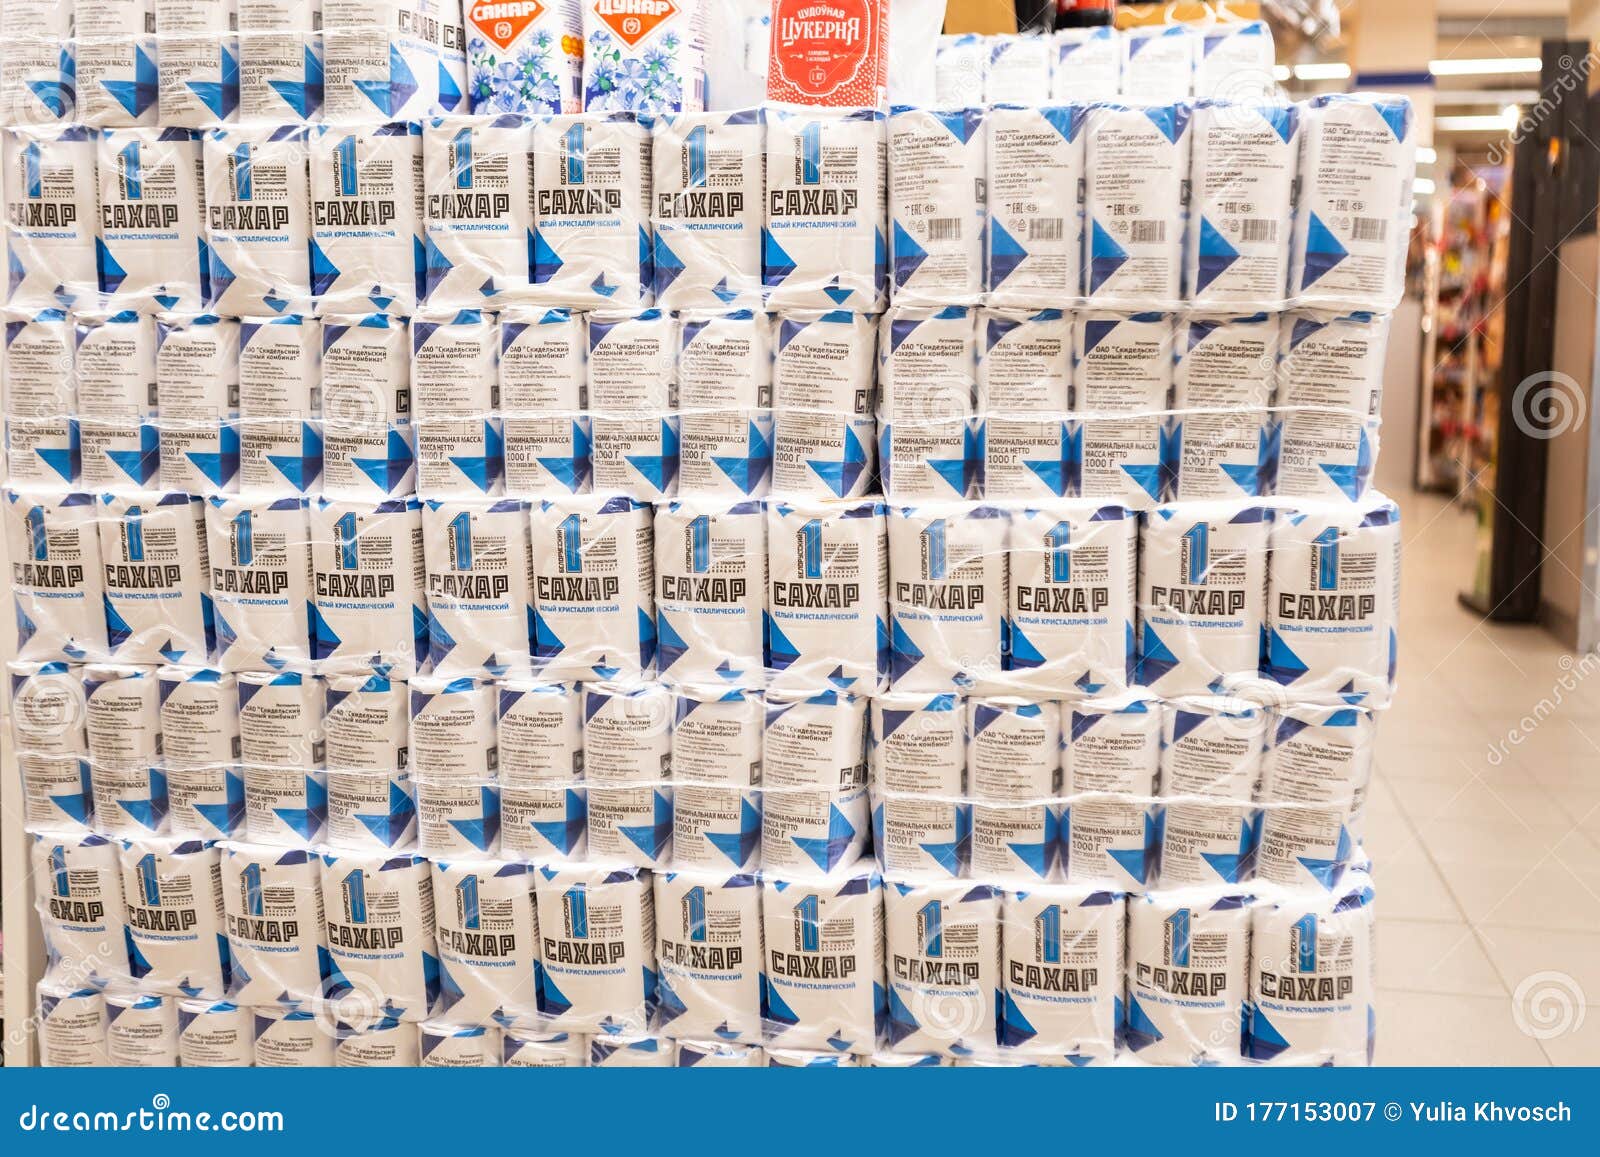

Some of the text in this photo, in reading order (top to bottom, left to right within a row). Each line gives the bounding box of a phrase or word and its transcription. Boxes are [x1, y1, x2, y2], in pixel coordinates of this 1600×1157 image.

[472, 1, 537, 21] САХАР
[797, 5, 845, 19] ЦУДОЎНАЯ
[782, 17, 860, 47] ЦУКЕРНЯ
[314, 200, 395, 225] САХАР
[428, 193, 510, 219] САХАР
[539, 189, 621, 215] САХАР
[659, 192, 744, 217] САХАР
[771, 189, 857, 215] САХАР
[102, 203, 178, 228] САХАР
[210, 206, 289, 230] САХАР
[771, 221, 790, 229] БЕЛЫЙ
[507, 453, 524, 461] 1000
[776, 453, 793, 461] 1000
[988, 455, 1009, 464] 1000
[1085, 458, 1106, 467] 1000
[106, 565, 181, 588] САХАР
[213, 568, 288, 594] САХАР
[316, 573, 394, 597] САХАР
[430, 574, 509, 599] САХАР
[537, 576, 619, 600] САХАР
[662, 575, 746, 602] САХАР
[335, 601, 395, 609] КРИСТАЛЛИЧЕСКИЙ
[774, 581, 859, 608] САХАР
[897, 582, 983, 609] САХАР
[1018, 585, 1108, 612] САХАР
[1152, 585, 1245, 615] САХАР
[1279, 592, 1375, 620] САХАР
[796, 612, 858, 620] КРИСТАЛЛИЧЕСКИЙ
[1279, 624, 1373, 633] БЕЛЫЙ КРИСТАЛЛИЧЕСКИЙ
[887, 836, 907, 845] 1000
[50, 898, 104, 922] АХАР
[128, 904, 197, 931] САХАР
[328, 922, 403, 949] САХАР
[544, 937, 624, 965] САХАР
[566, 966, 625, 975] КРИСТАЛЛИЧЕСКИЙ
[772, 950, 856, 978] САХАР
[894, 954, 979, 985] САХАР
[1010, 960, 1097, 992] САХАР
[794, 981, 856, 990] КРИСТАЛЛИЧЕСКИЙ
[1136, 961, 1226, 996] САХАР
[1261, 971, 1353, 1001] САХАР
